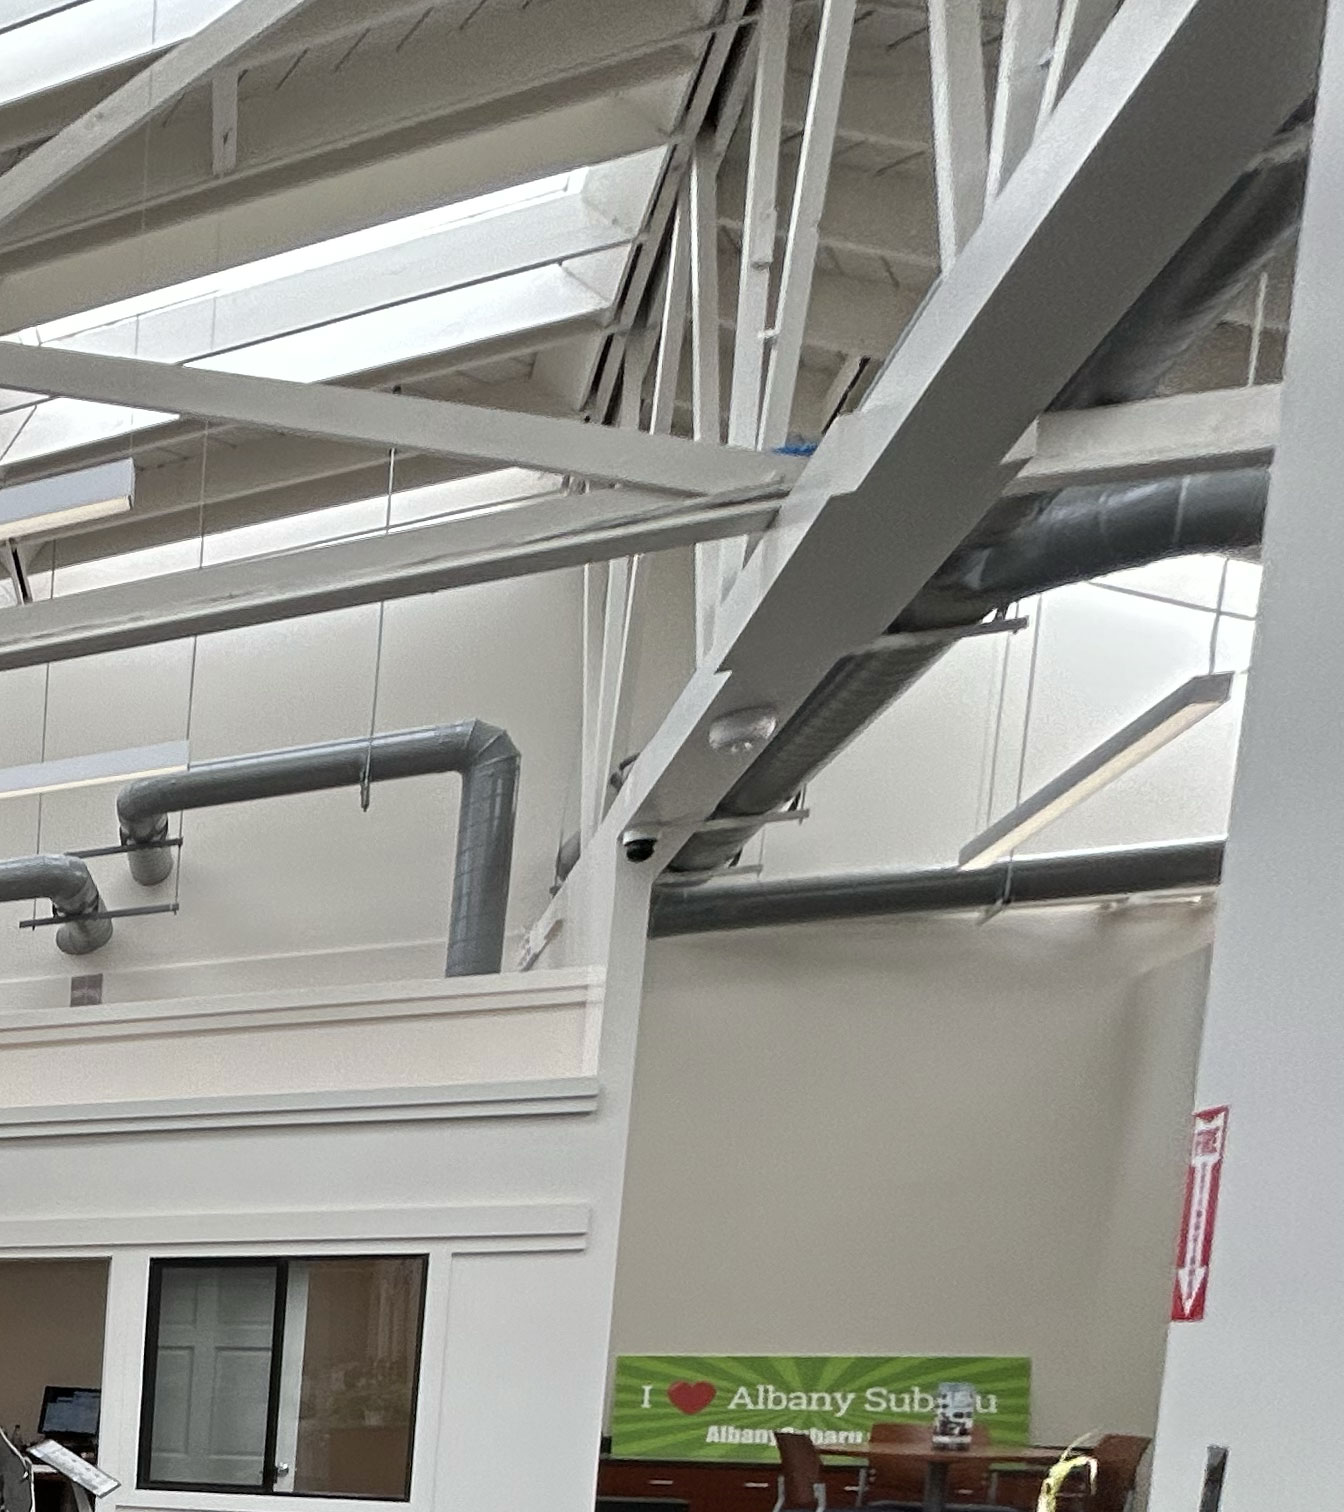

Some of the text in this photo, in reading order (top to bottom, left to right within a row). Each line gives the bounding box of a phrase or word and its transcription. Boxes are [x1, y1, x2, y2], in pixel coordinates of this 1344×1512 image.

[640, 1384, 998, 1418] I Albany Subu
